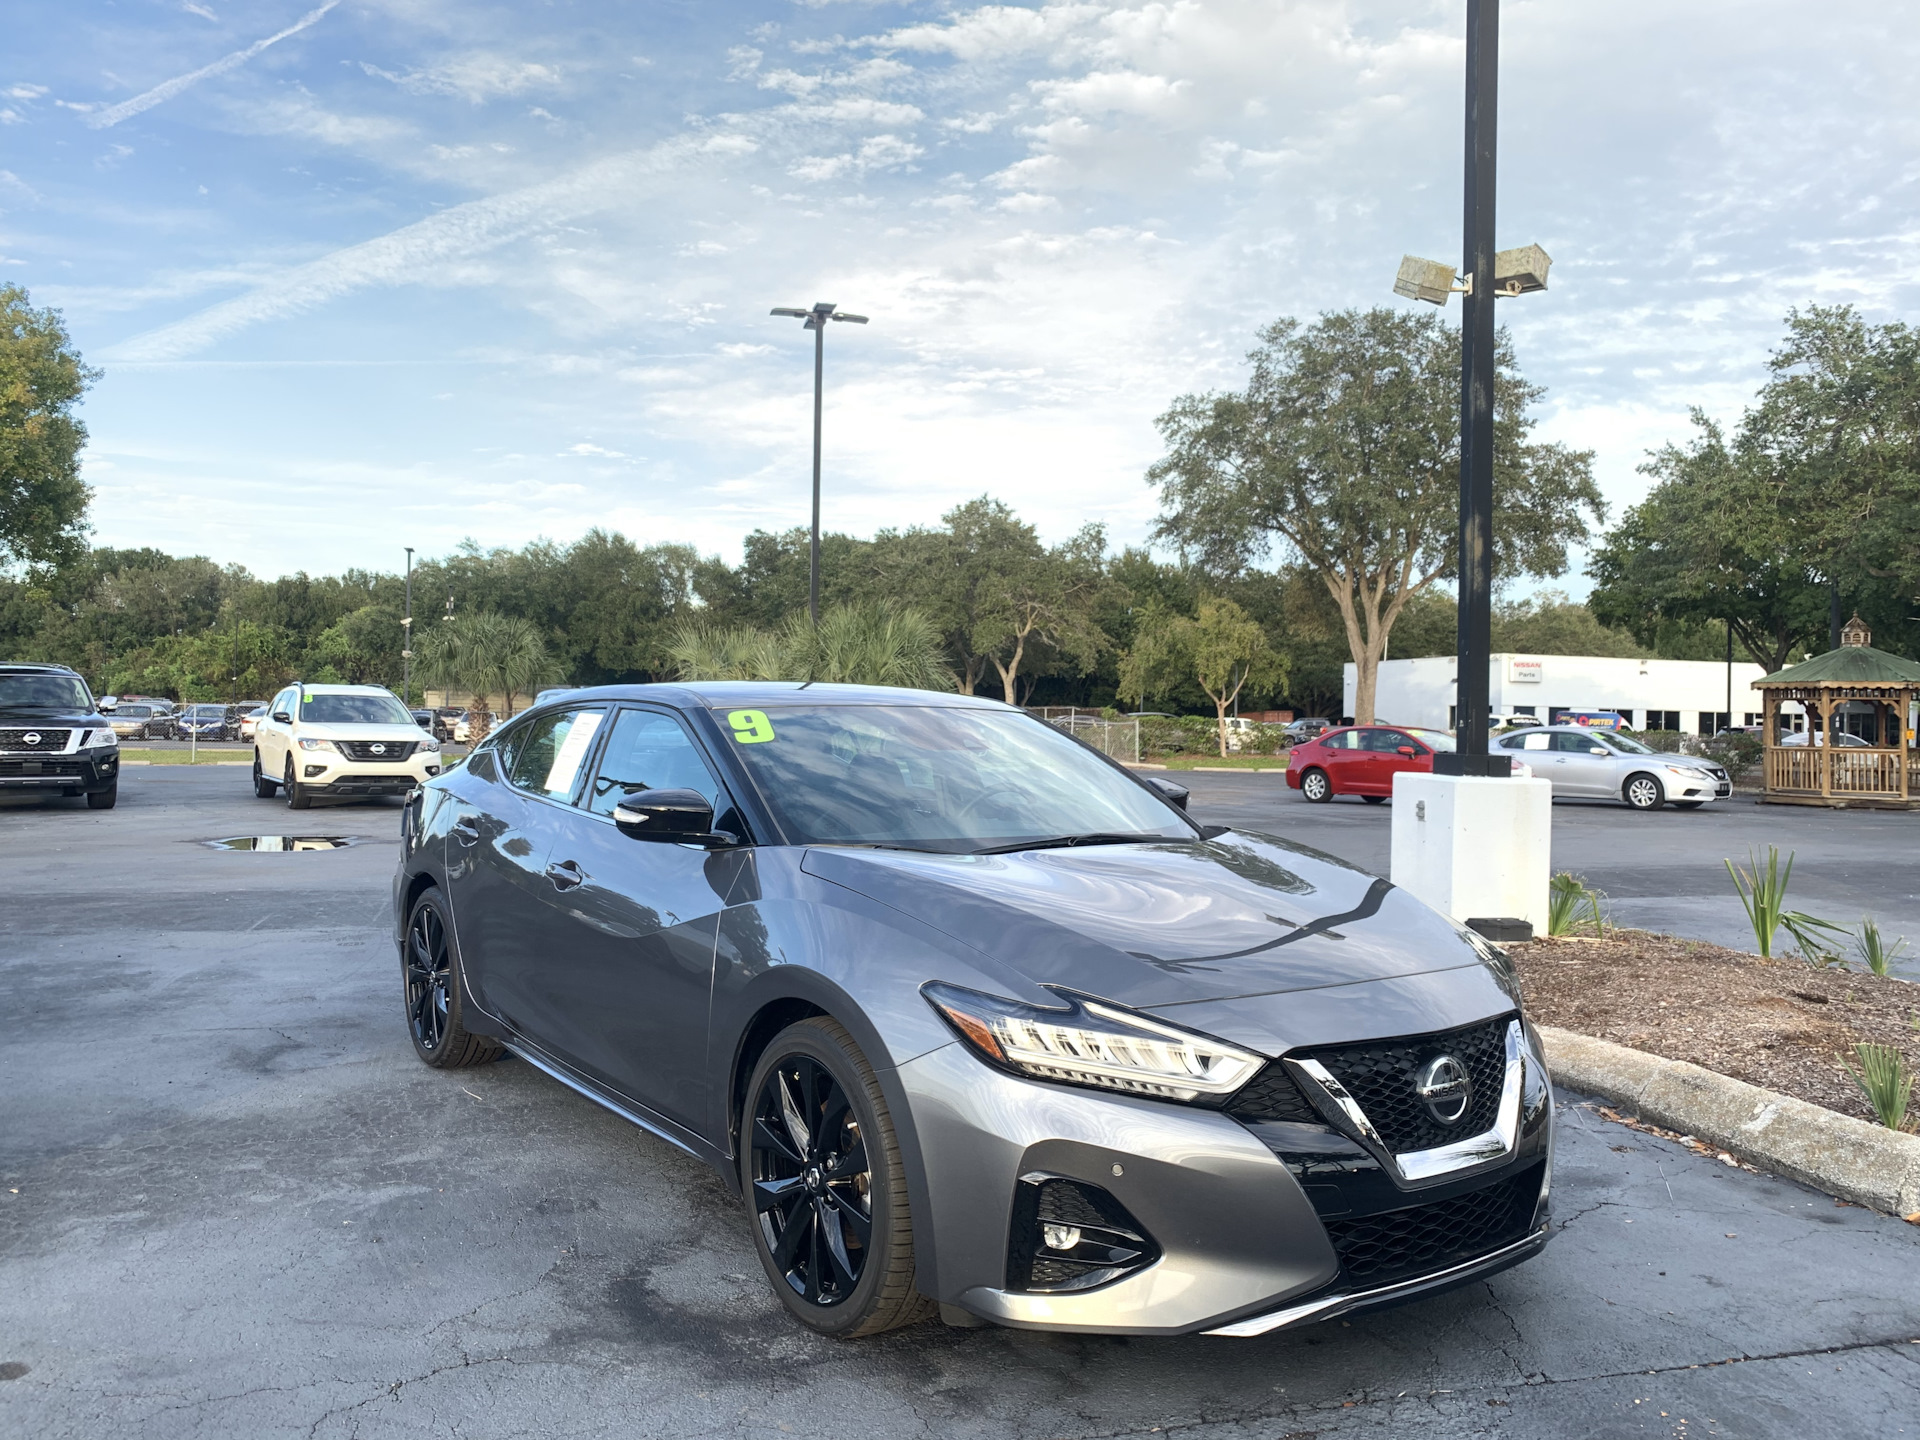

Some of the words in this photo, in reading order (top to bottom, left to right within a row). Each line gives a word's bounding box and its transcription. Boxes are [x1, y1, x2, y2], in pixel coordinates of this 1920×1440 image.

[727, 709, 776, 744] 9
[1588, 718, 1614, 726] PIRTEK
[1431, 1082, 1467, 1098] NISSAN
